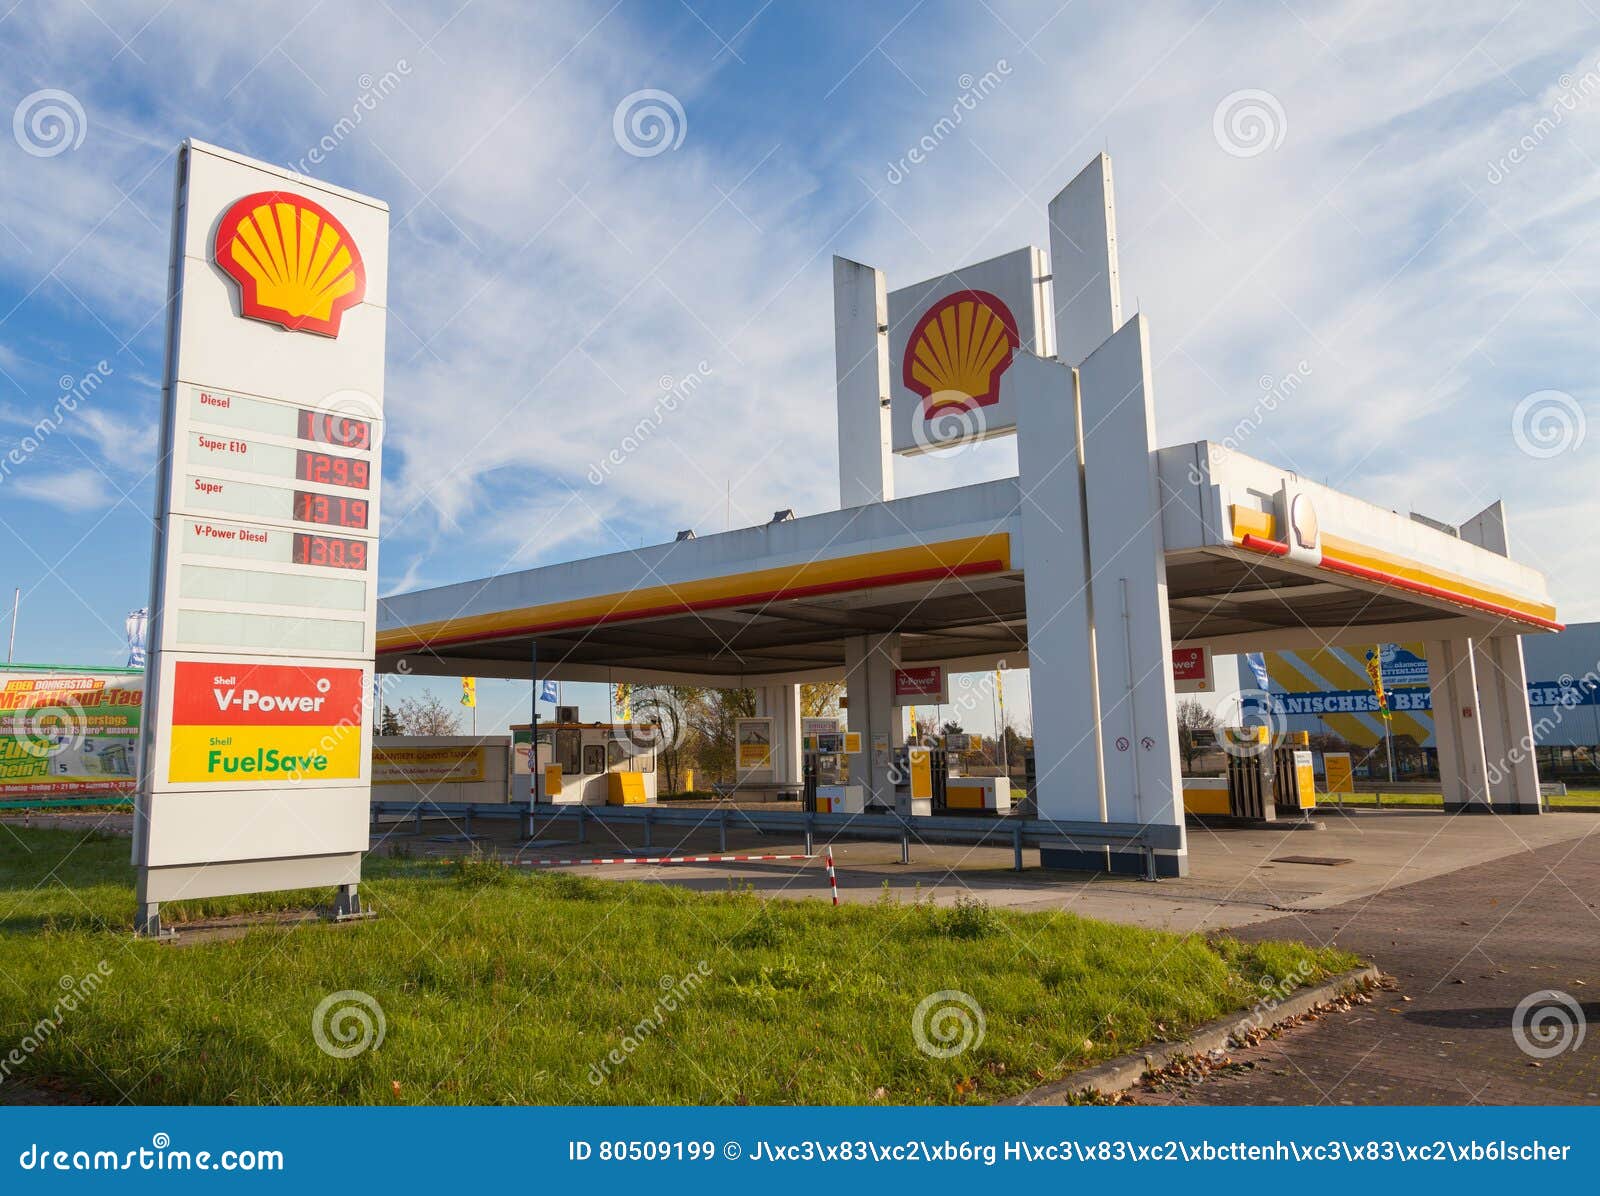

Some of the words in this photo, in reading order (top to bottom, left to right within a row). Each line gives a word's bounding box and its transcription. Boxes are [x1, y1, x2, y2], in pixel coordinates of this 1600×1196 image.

[200, 392, 231, 409] Diesel
[199, 436, 226, 452] Super
[229, 441, 247, 454] E10
[194, 479, 223, 495] Super
[194, 524, 236, 541] V-Power
[239, 529, 268, 543] Diesel
[213, 676, 236, 686] Shell
[213, 688, 326, 713] V-Power
[209, 737, 232, 746] Shell
[208, 747, 328, 774] FuelSave
